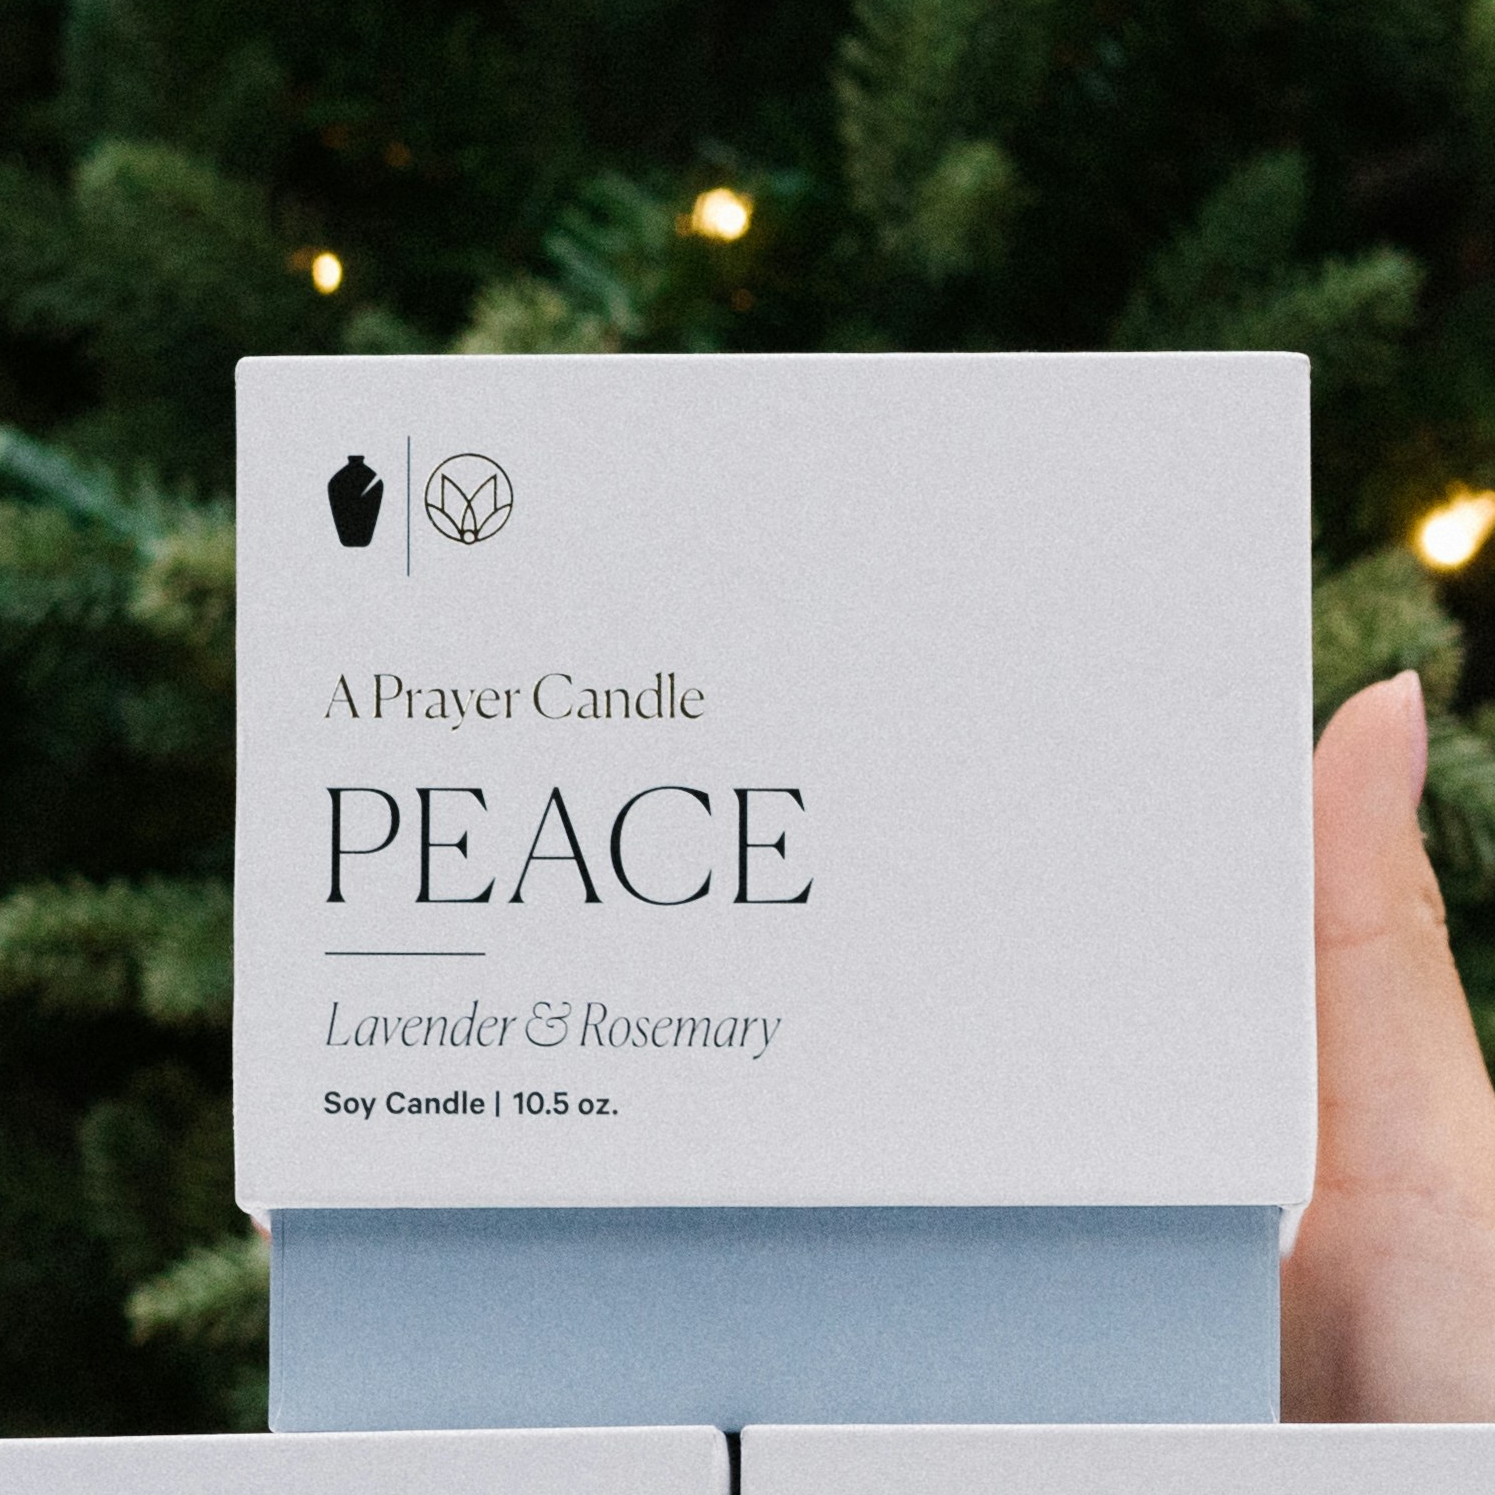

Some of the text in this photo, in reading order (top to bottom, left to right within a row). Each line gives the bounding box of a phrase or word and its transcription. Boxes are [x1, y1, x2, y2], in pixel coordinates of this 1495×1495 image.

[323, 669, 707, 733] A Prayer Candle
[323, 783, 816, 908] PEACE
[324, 997, 784, 1062] Lavender & Rosemary
[322, 1089, 379, 1122] Soy
[383, 1088, 487, 1117] Candle
[511, 1089, 571, 1117] 10.5
[576, 1096, 620, 1118] oz.
